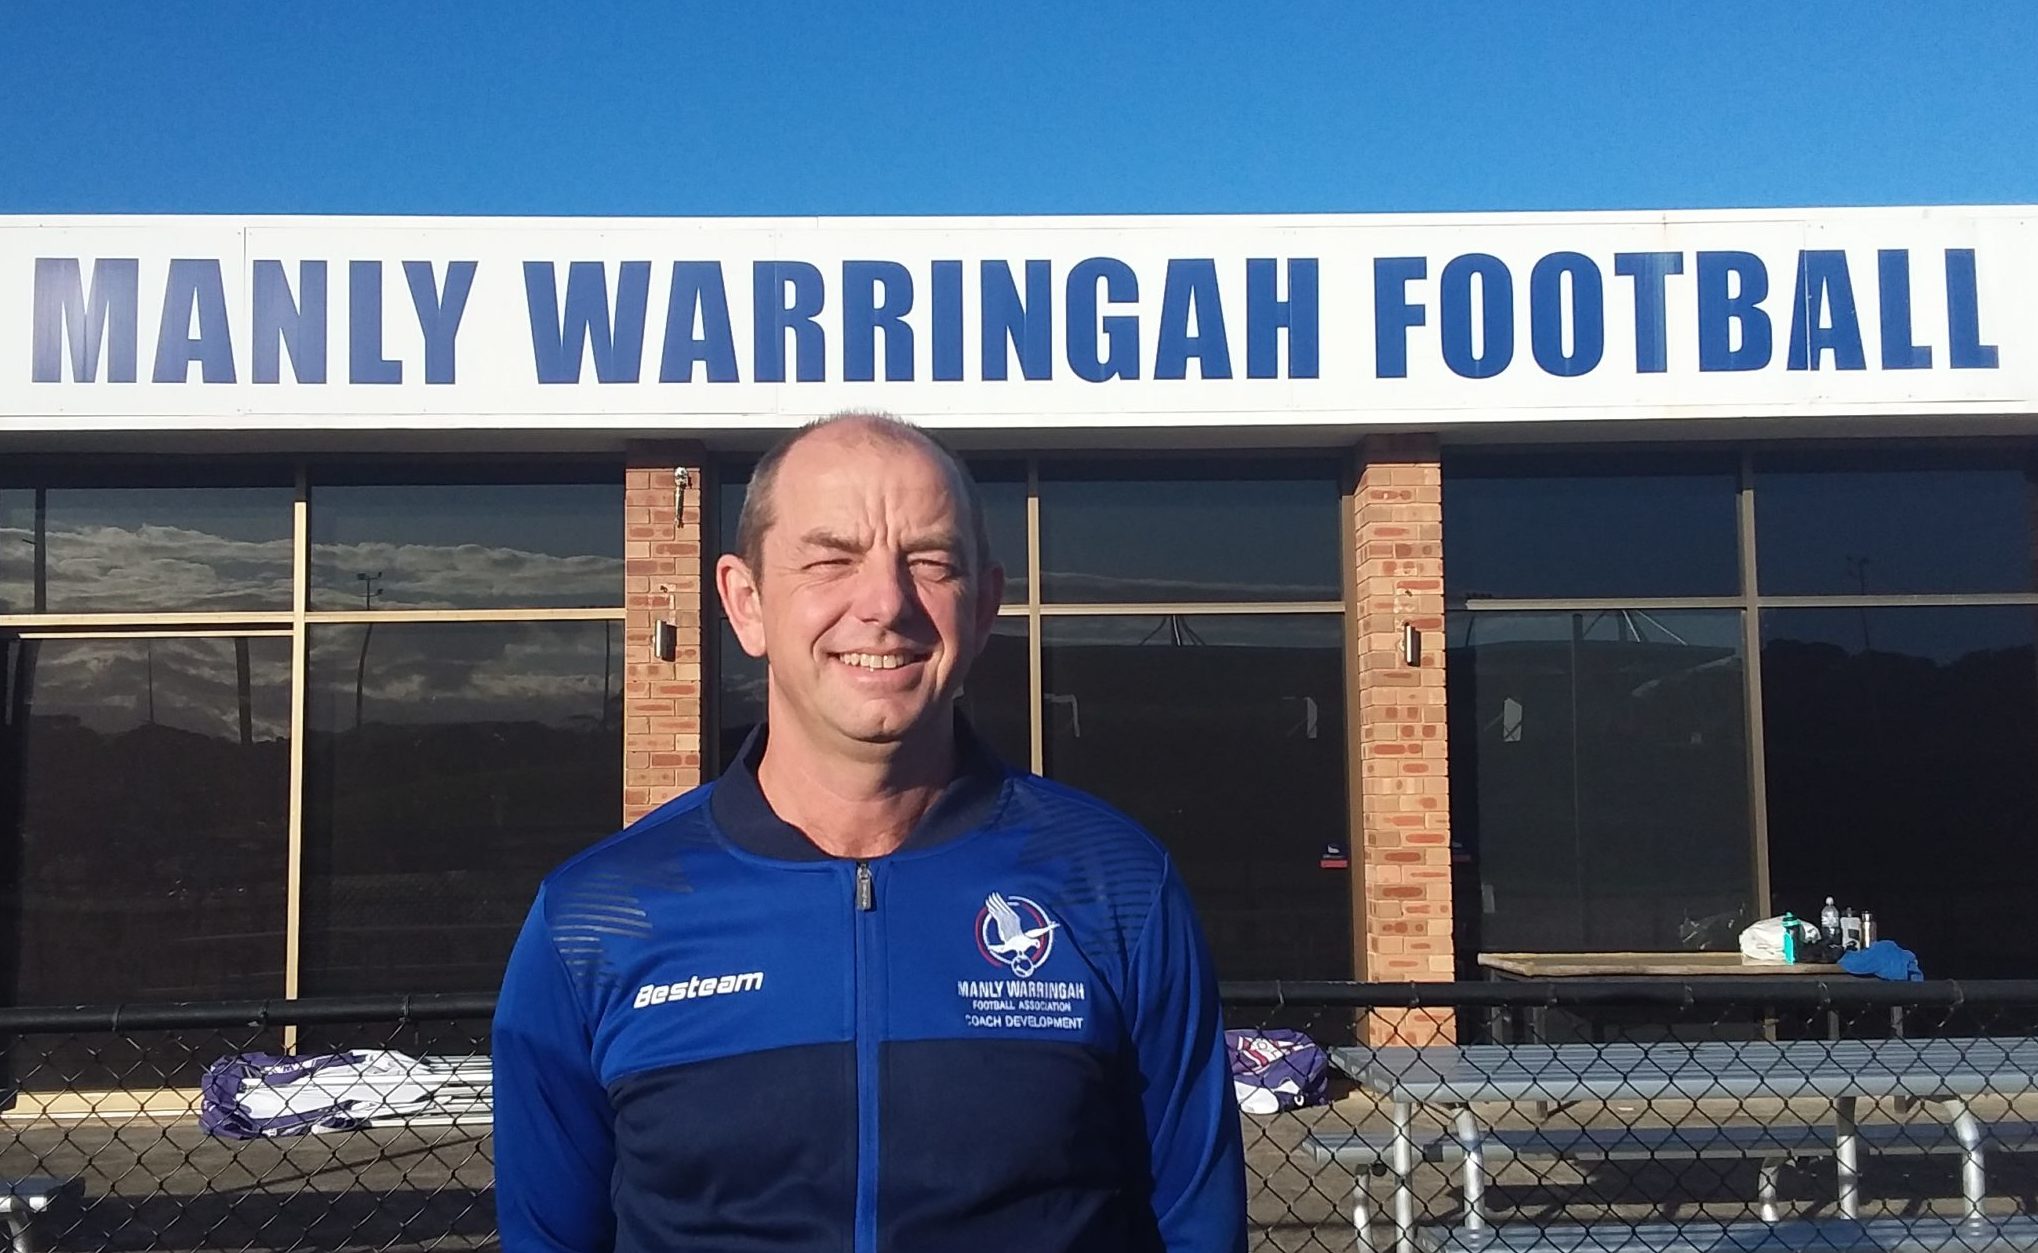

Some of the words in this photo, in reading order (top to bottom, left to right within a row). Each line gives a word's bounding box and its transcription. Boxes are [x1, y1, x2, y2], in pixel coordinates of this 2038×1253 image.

[32, 258, 478, 385] MANLY
[523, 257, 1320, 385] WARRINGAH
[1373, 247, 1999, 379] FOOTBALL
[633, 971, 765, 1009] Besteam
[957, 980, 1004, 999] MANLY
[1006, 980, 1085, 1000] WARRINGAH
[972, 1000, 1016, 1012] FOOTBALL
[1018, 1000, 1072, 1012] ASSOCIATION
[1005, 1015, 1084, 1030] DEVELOPMENT
